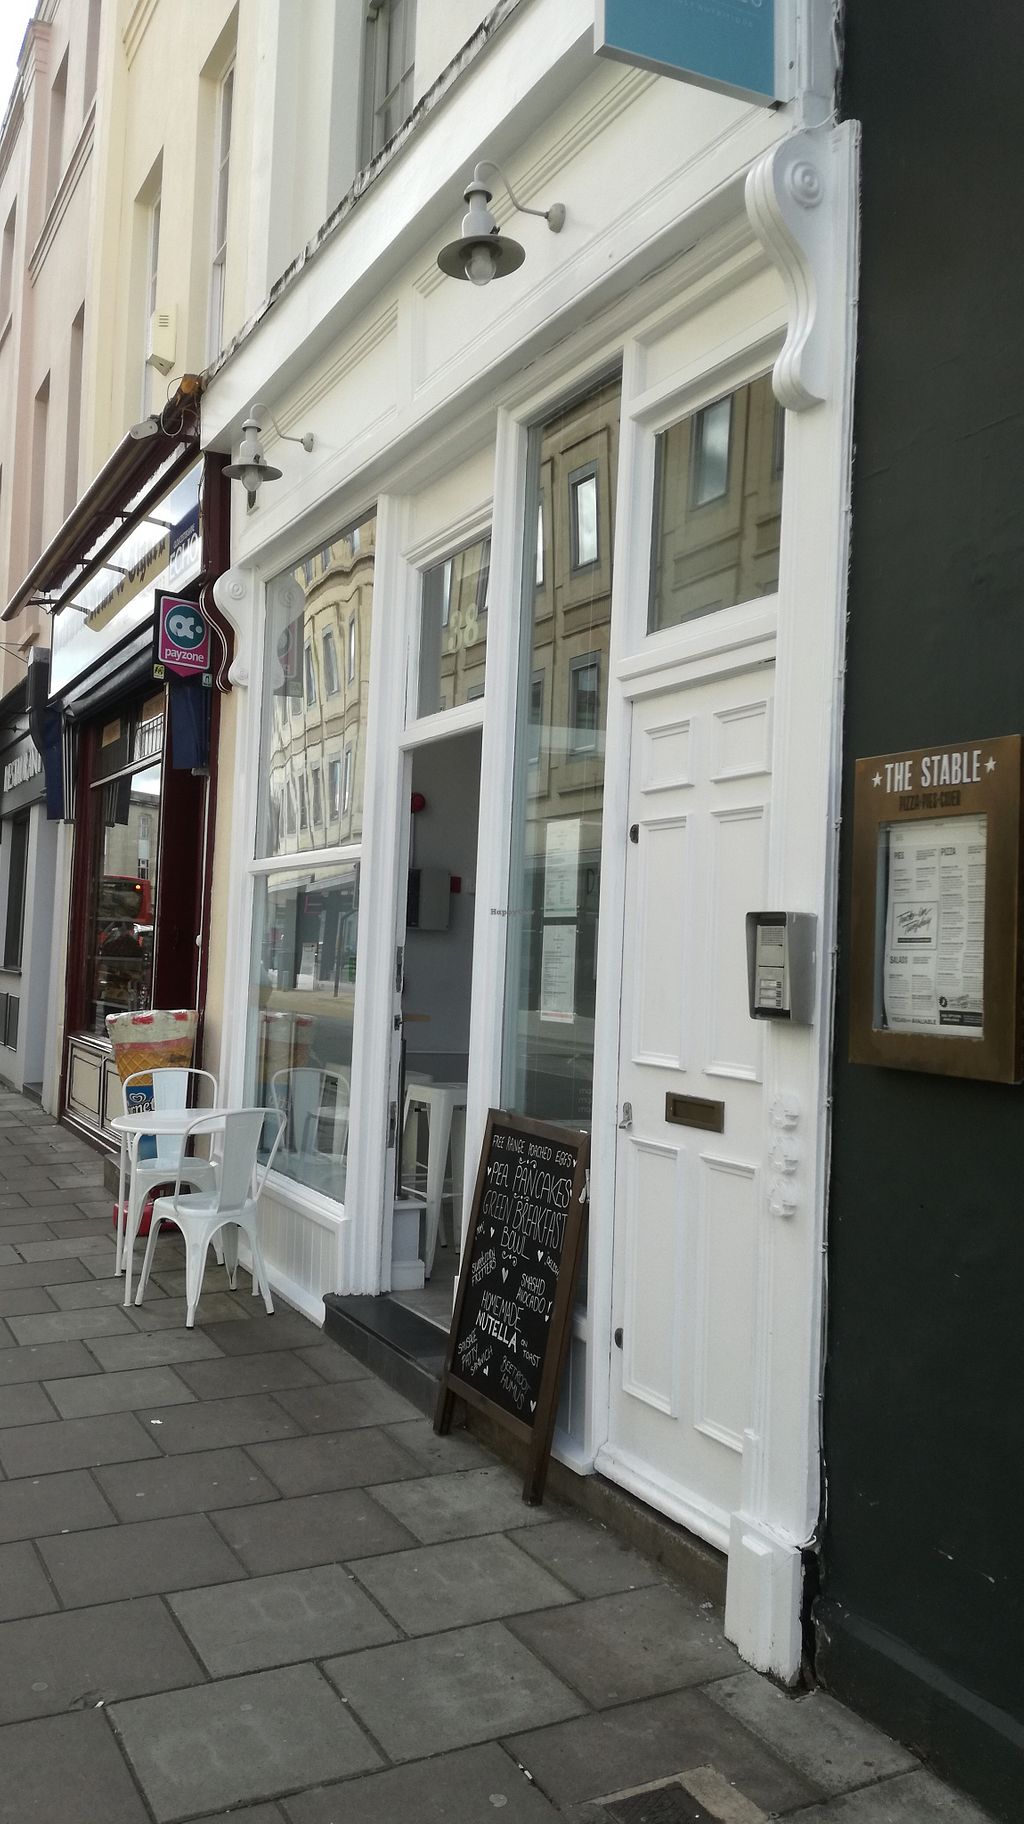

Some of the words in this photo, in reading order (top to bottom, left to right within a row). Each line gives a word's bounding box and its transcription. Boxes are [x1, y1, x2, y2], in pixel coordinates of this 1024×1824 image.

[165, 648, 204, 662] payzone
[885, 761, 913, 793] THE
[921, 750, 982, 787] STABLE
[492, 1134, 505, 1149] FREE
[506, 1135, 526, 1154] RANGE
[528, 1142, 552, 1161] POACHED
[555, 1150, 572, 1168] EGGS
[490, 1161, 509, 1188] PEA
[512, 1166, 571, 1208] PANCAKES
[483, 1190, 512, 1224] GREEN
[512, 1200, 568, 1253] BREAKFAST
[501, 1225, 530, 1260] BOWL
[475, 1310, 517, 1353] NUTELLA
[520, 1338, 529, 1348] ON
[523, 1350, 541, 1368] TOAST
